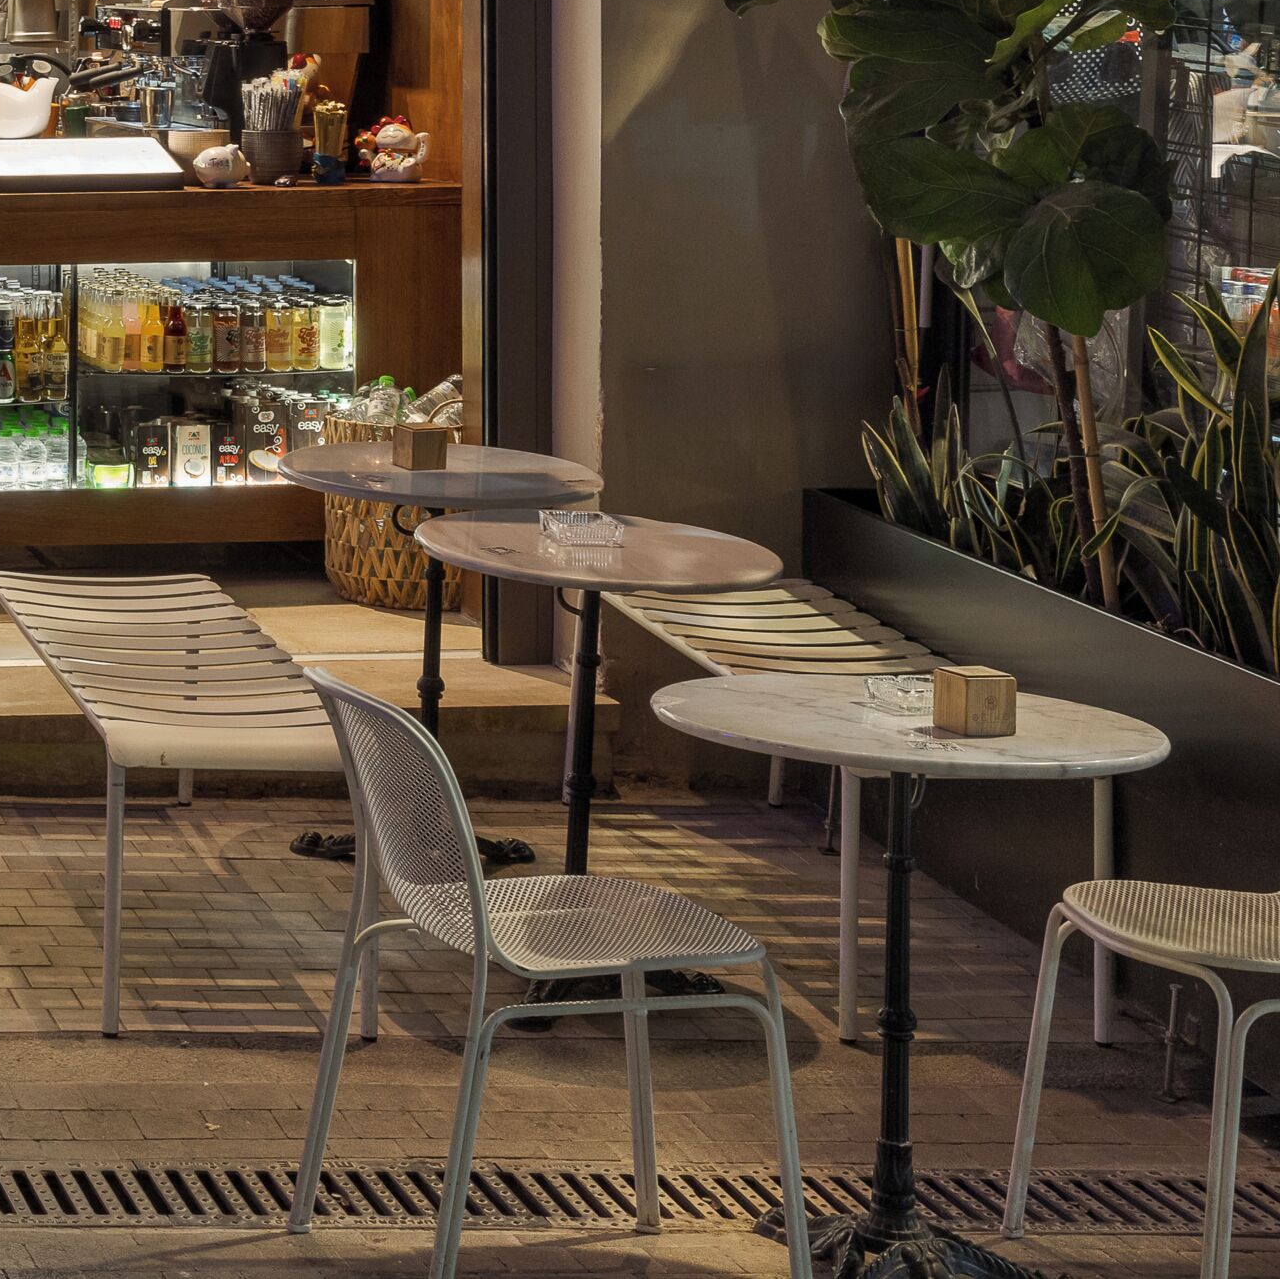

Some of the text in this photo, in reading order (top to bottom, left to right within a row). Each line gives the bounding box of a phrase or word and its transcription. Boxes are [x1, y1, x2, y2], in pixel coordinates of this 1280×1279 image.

[253, 424, 279, 435] easy
[298, 421, 324, 432] easy
[142, 446, 164, 456] easy
[219, 445, 240, 454] easy
